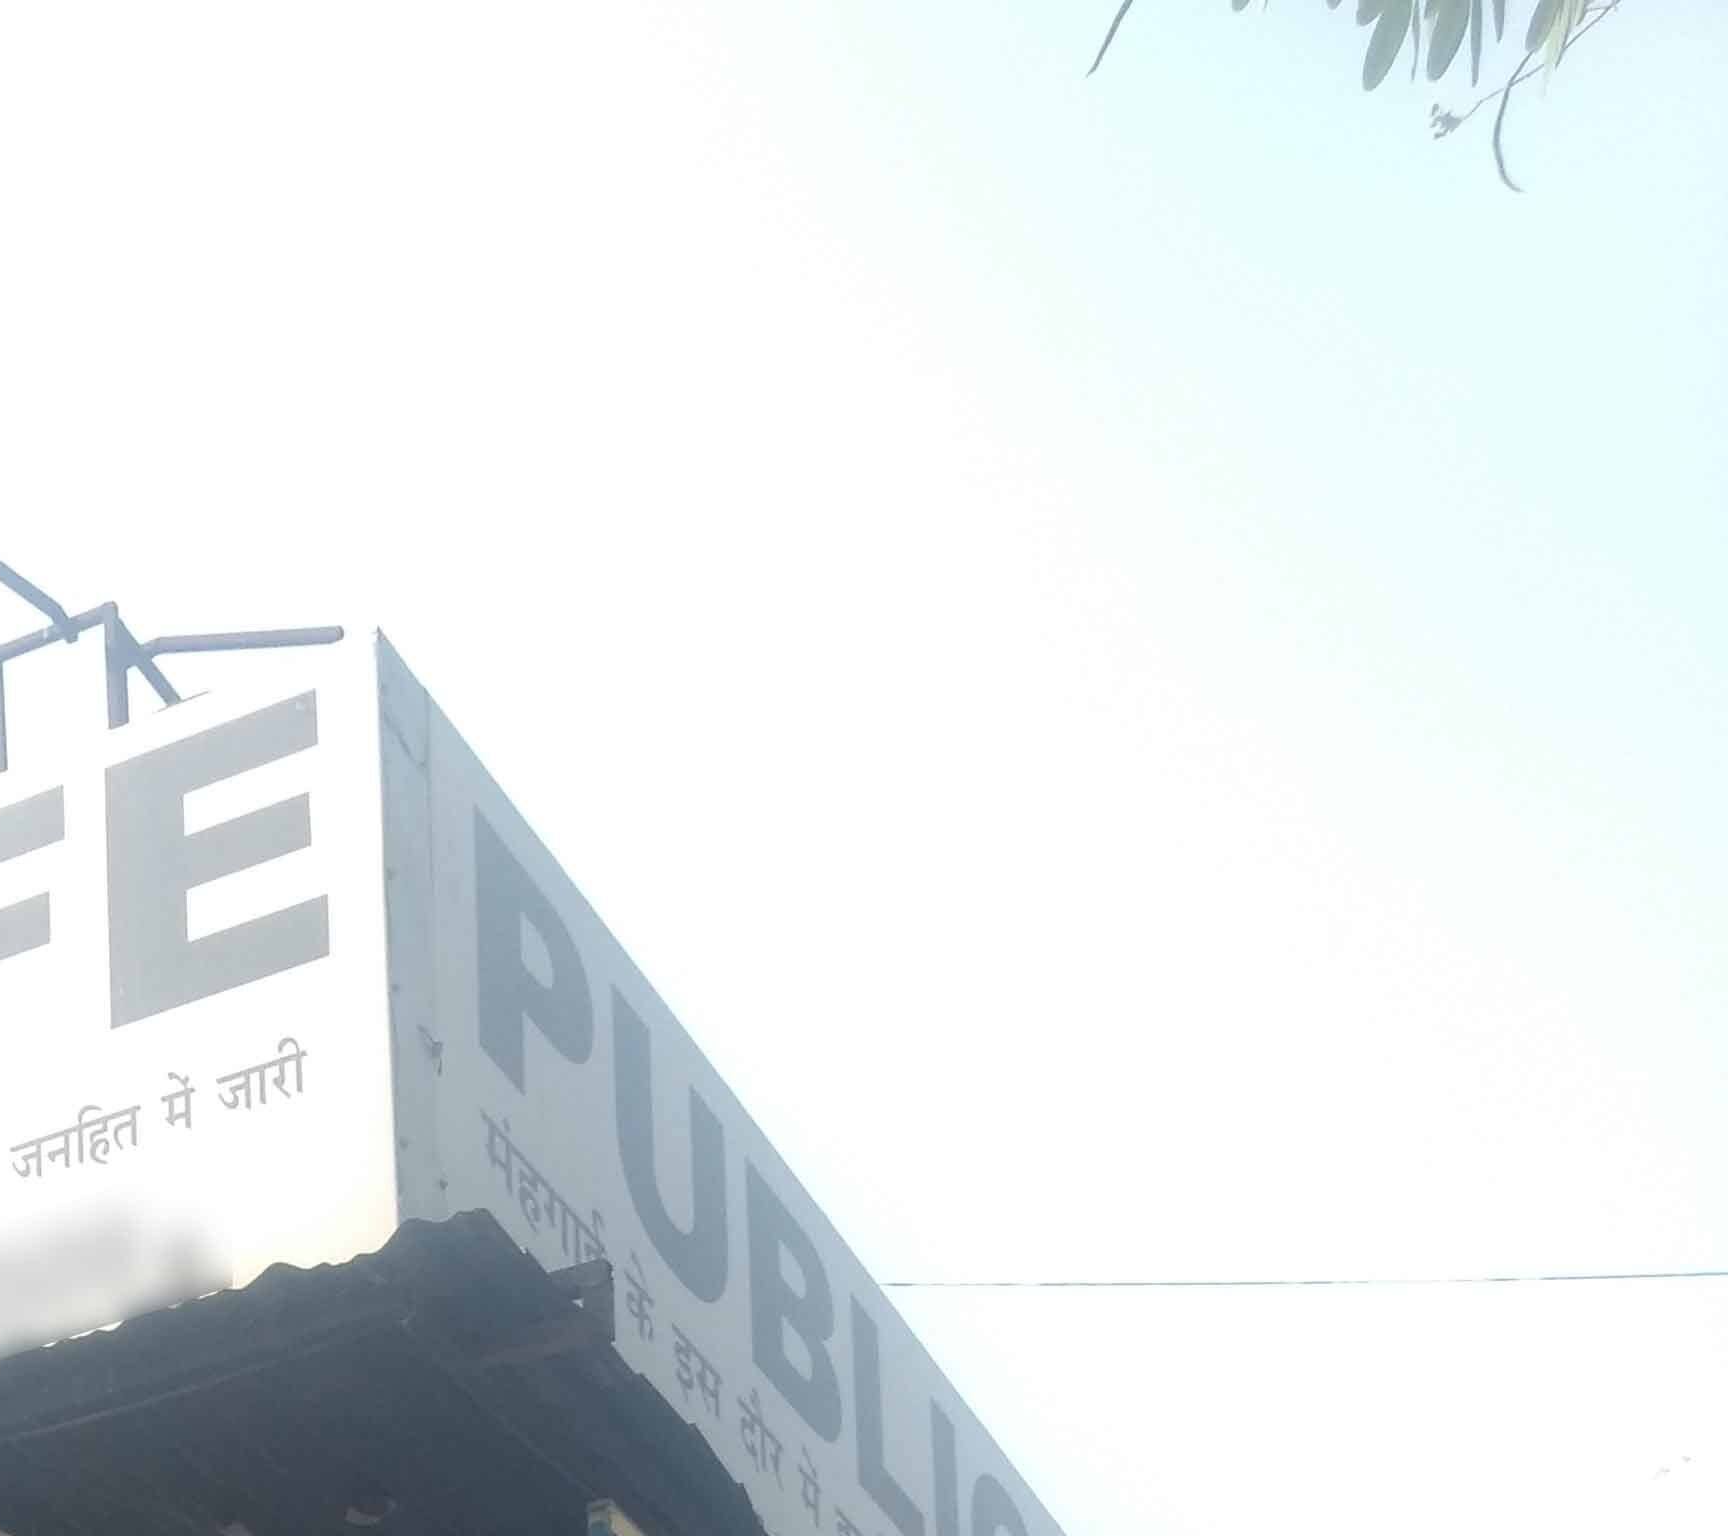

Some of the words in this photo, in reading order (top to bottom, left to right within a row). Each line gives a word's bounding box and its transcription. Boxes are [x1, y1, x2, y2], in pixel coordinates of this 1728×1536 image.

[10, 1105, 141, 1181] जनहित
[160, 1073, 195, 1133] में
[217, 1036, 308, 1112] जारी
